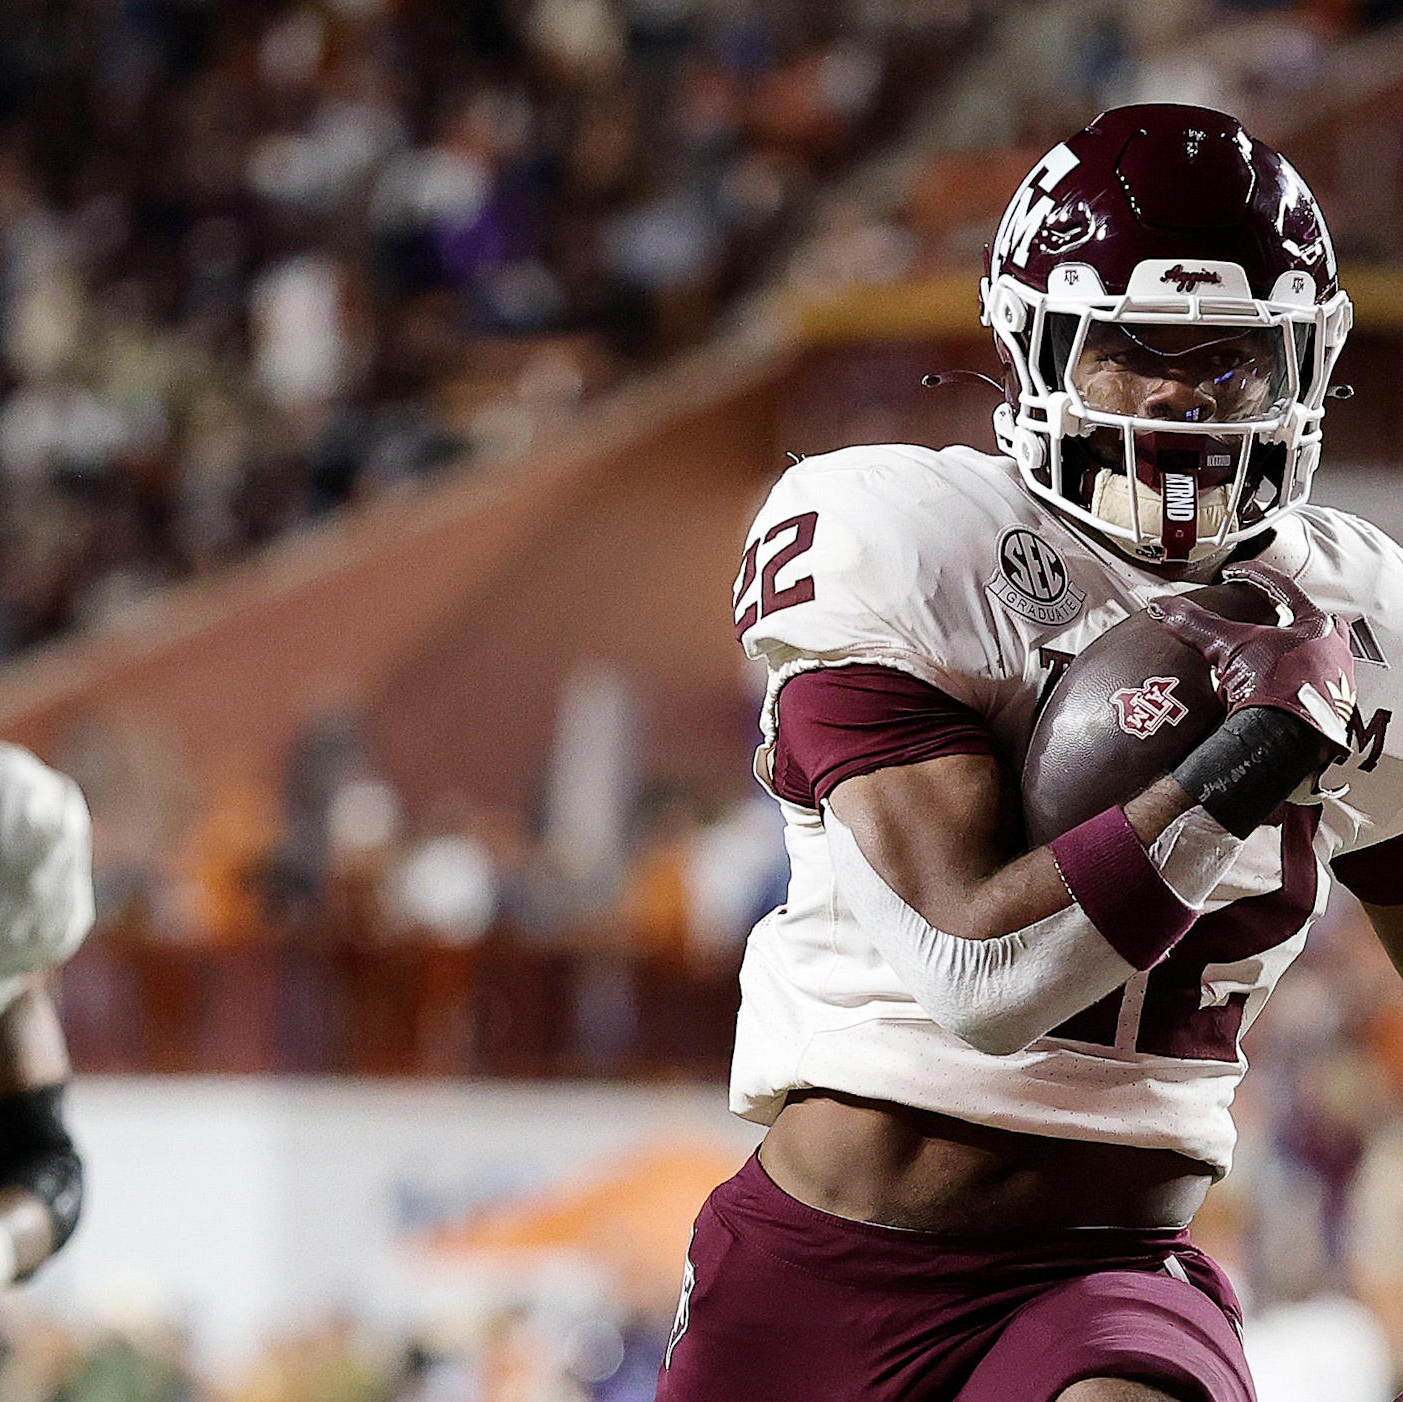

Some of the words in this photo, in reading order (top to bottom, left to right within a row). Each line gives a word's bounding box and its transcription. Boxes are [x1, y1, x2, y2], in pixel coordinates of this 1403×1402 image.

[1165, 473, 1195, 521] XTRND
[1001, 530, 1065, 601] SEC
[1005, 591, 1077, 622] GRADUATE
